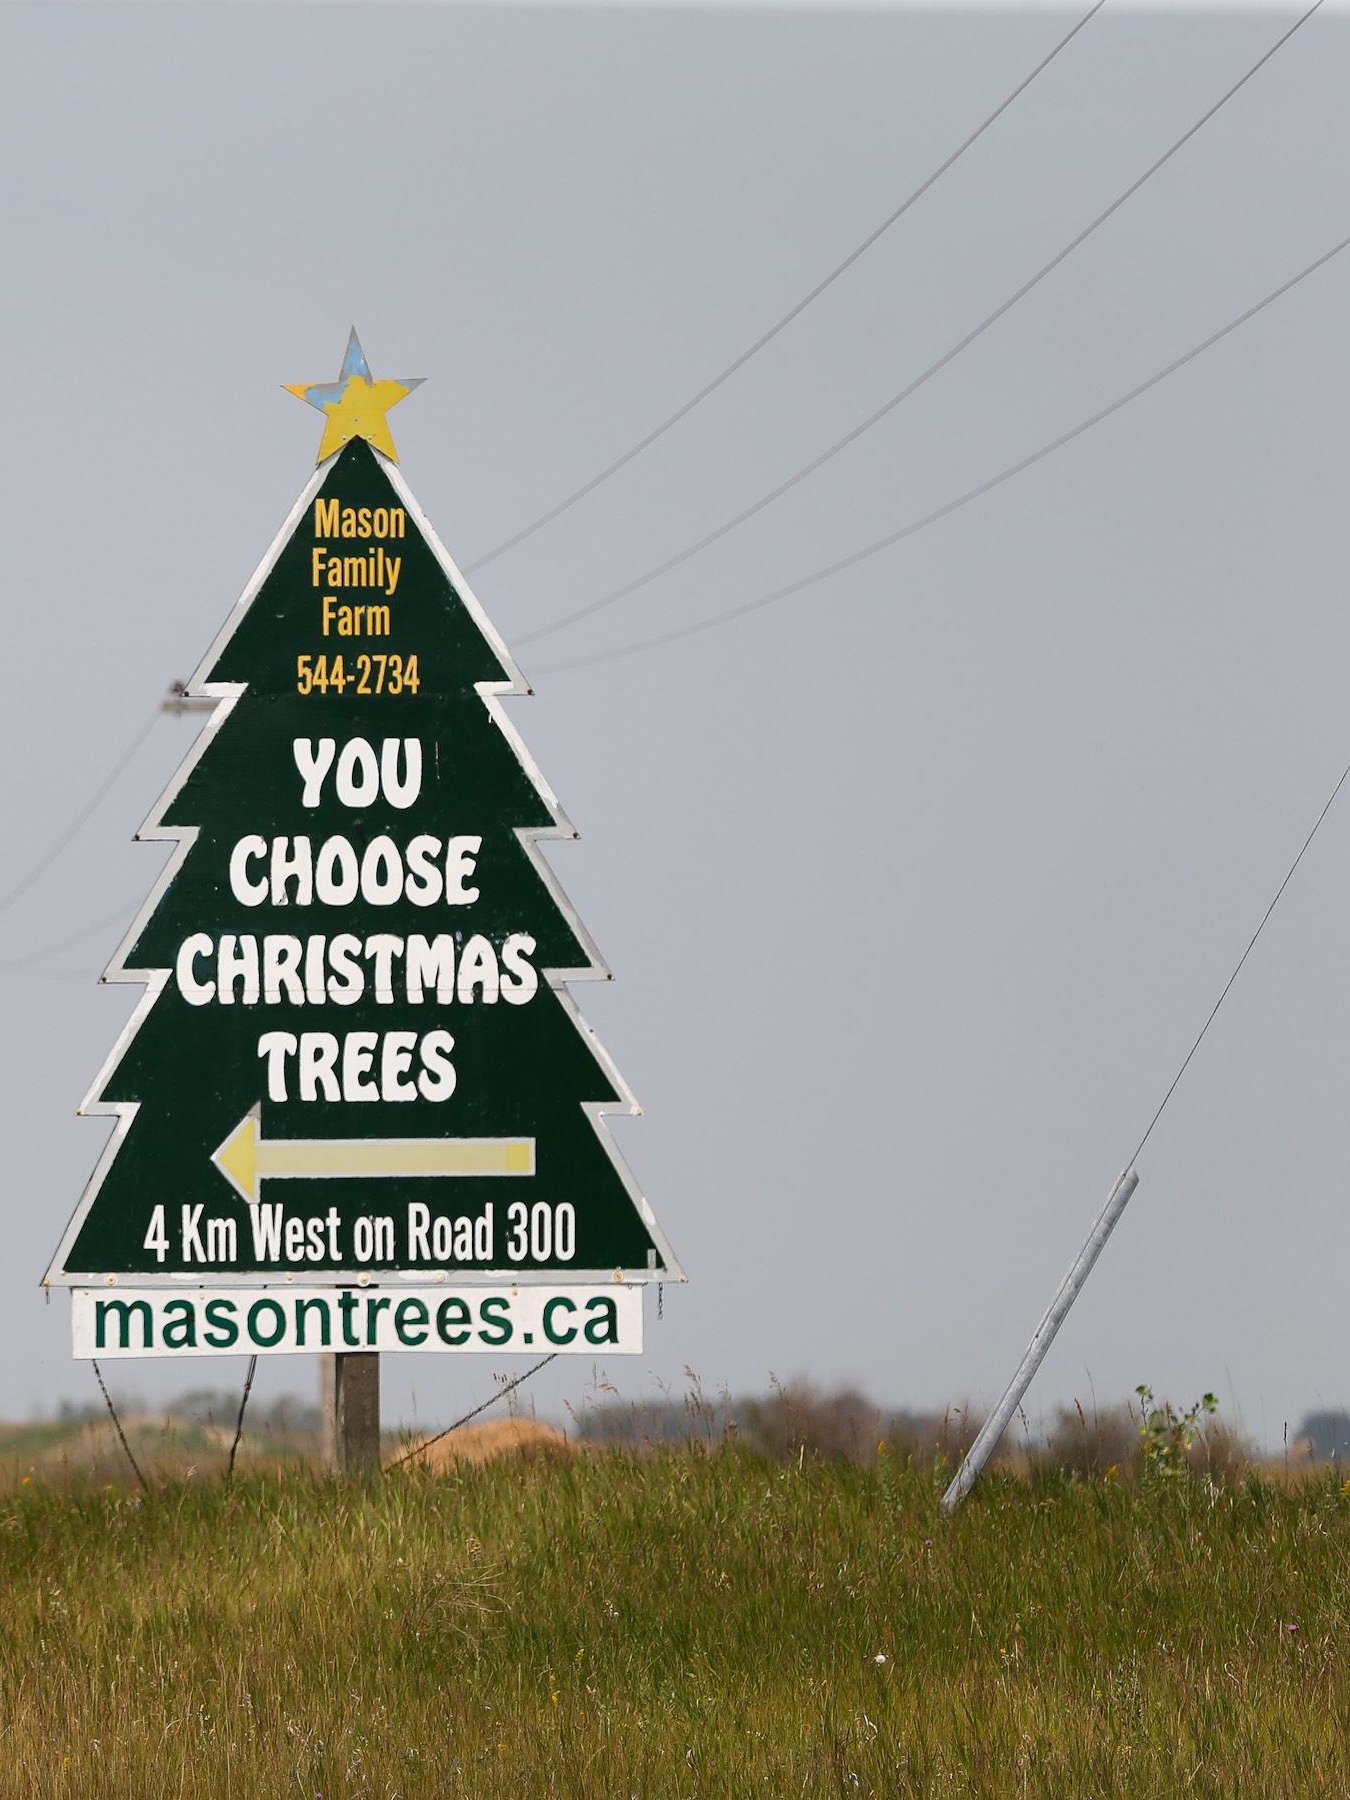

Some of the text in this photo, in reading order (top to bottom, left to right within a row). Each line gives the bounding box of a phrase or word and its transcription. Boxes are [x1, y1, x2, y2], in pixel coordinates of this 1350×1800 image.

[314, 498, 405, 538] Mason
[312, 547, 401, 595] Family
[322, 596, 391, 636] Farm
[297, 654, 420, 695] 544-2734
[293, 737, 422, 809] YOU
[229, 835, 483, 907] CHOOSE
[176, 932, 538, 1006] CHRISTMAS
[257, 1029, 457, 1102] TREES
[143, 1201, 577, 1263] 4 Km West on Road 300
[94, 1290, 620, 1349] masontrees.ca
